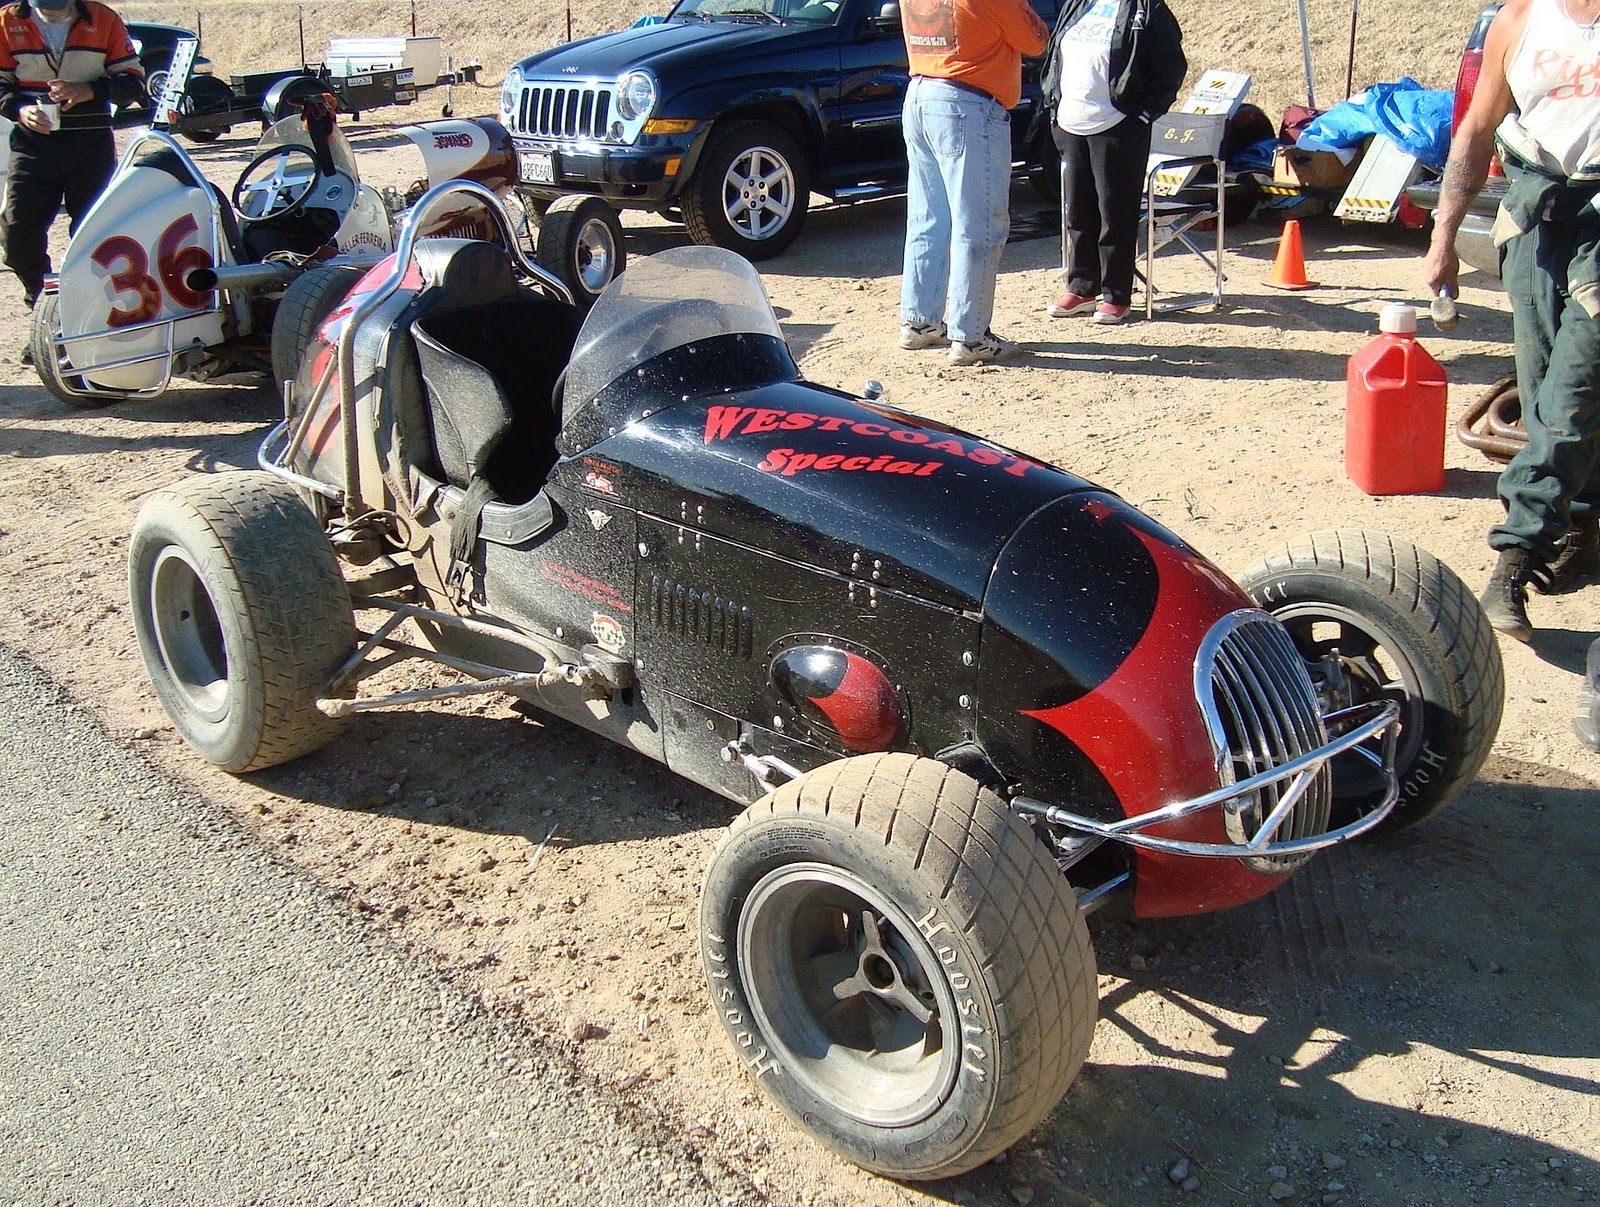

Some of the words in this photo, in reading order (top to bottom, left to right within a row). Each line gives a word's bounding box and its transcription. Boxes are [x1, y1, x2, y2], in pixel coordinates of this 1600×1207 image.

[90, 212, 214, 329] 36
[340, 232, 387, 253] EELER-FERREIRA
[704, 405, 1047, 478] WESTCOAST
[757, 447, 944, 478] Special
[706, 925, 781, 1080] Hoosier
[914, 905, 991, 1084] Hoosier
